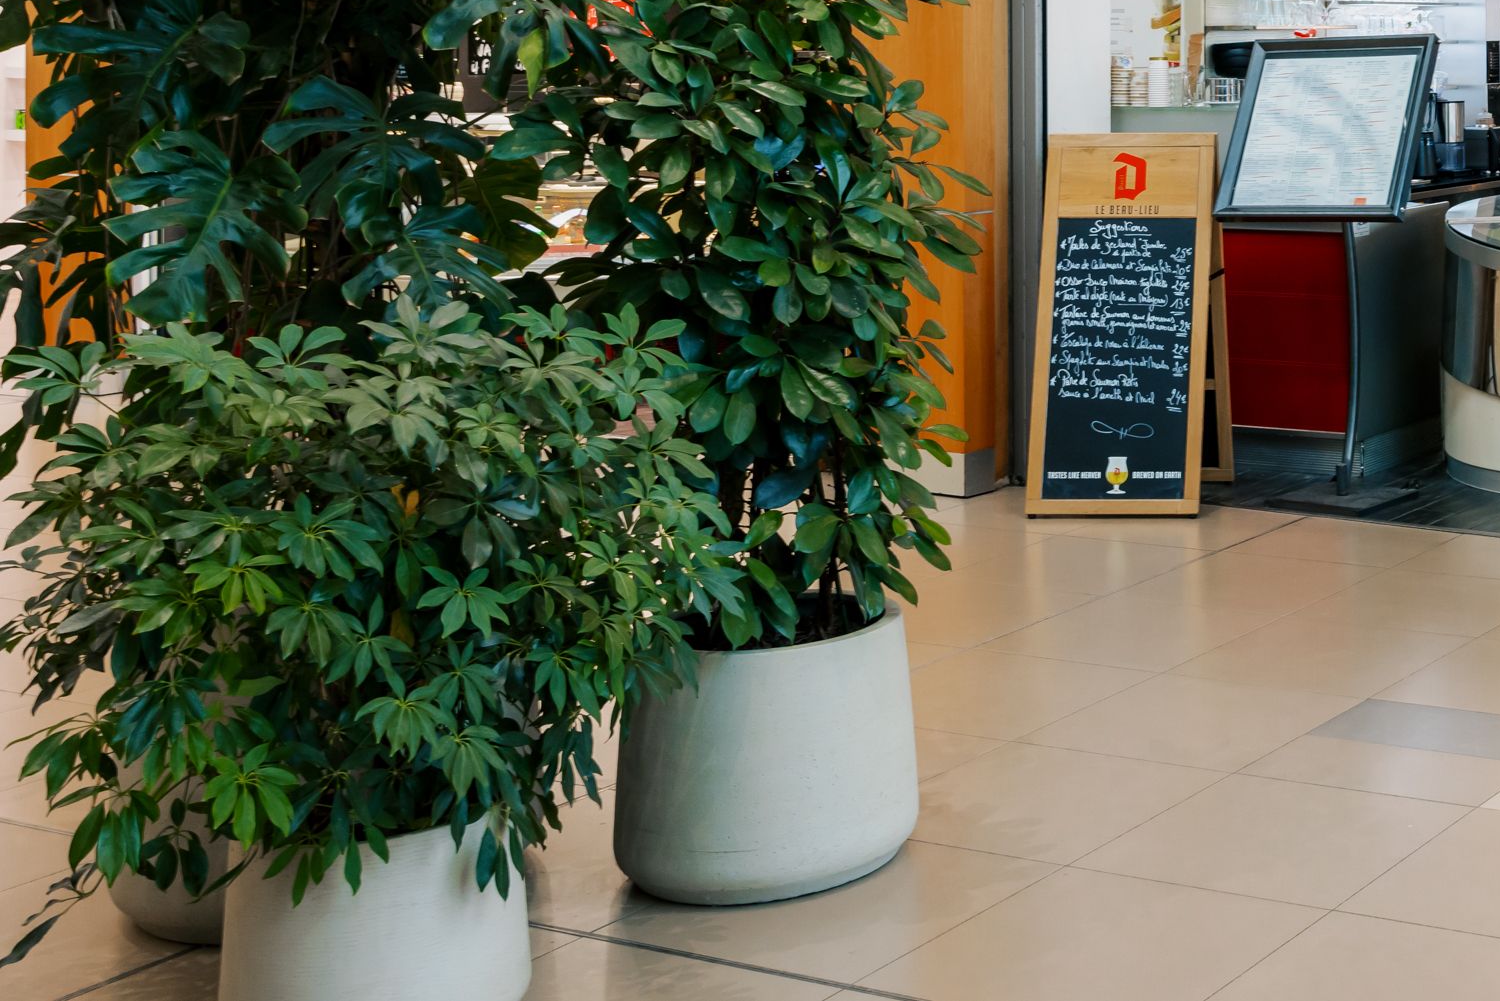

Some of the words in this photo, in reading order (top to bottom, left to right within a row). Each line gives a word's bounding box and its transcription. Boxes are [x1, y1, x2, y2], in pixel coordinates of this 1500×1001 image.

[1095, 205, 1105, 215] LE
[1110, 205, 1160, 215] BEAU-LIEU
[1089, 220, 1149, 239] Suggestions
[1091, 238, 1101, 250] de
[1081, 259, 1090, 270] de
[1091, 307, 1101, 318] de
[1094, 335, 1104, 347] de
